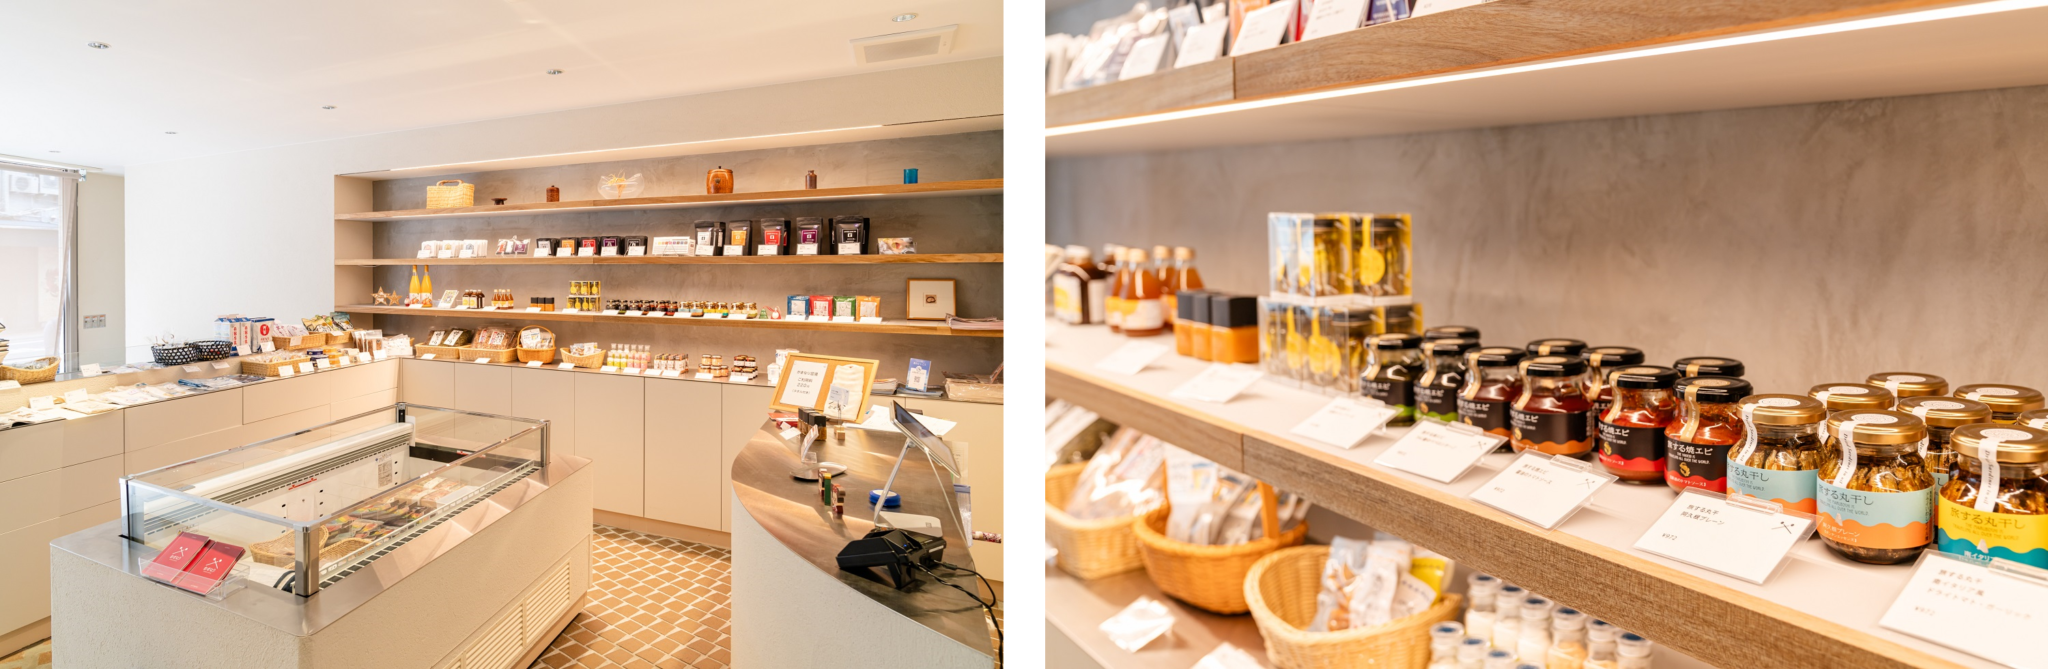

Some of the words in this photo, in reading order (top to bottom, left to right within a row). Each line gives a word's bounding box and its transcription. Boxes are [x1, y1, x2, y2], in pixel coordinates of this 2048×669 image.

[1726, 462, 1770, 482] する丸干し
[1950, 507, 2026, 531] 旅する丸干し
